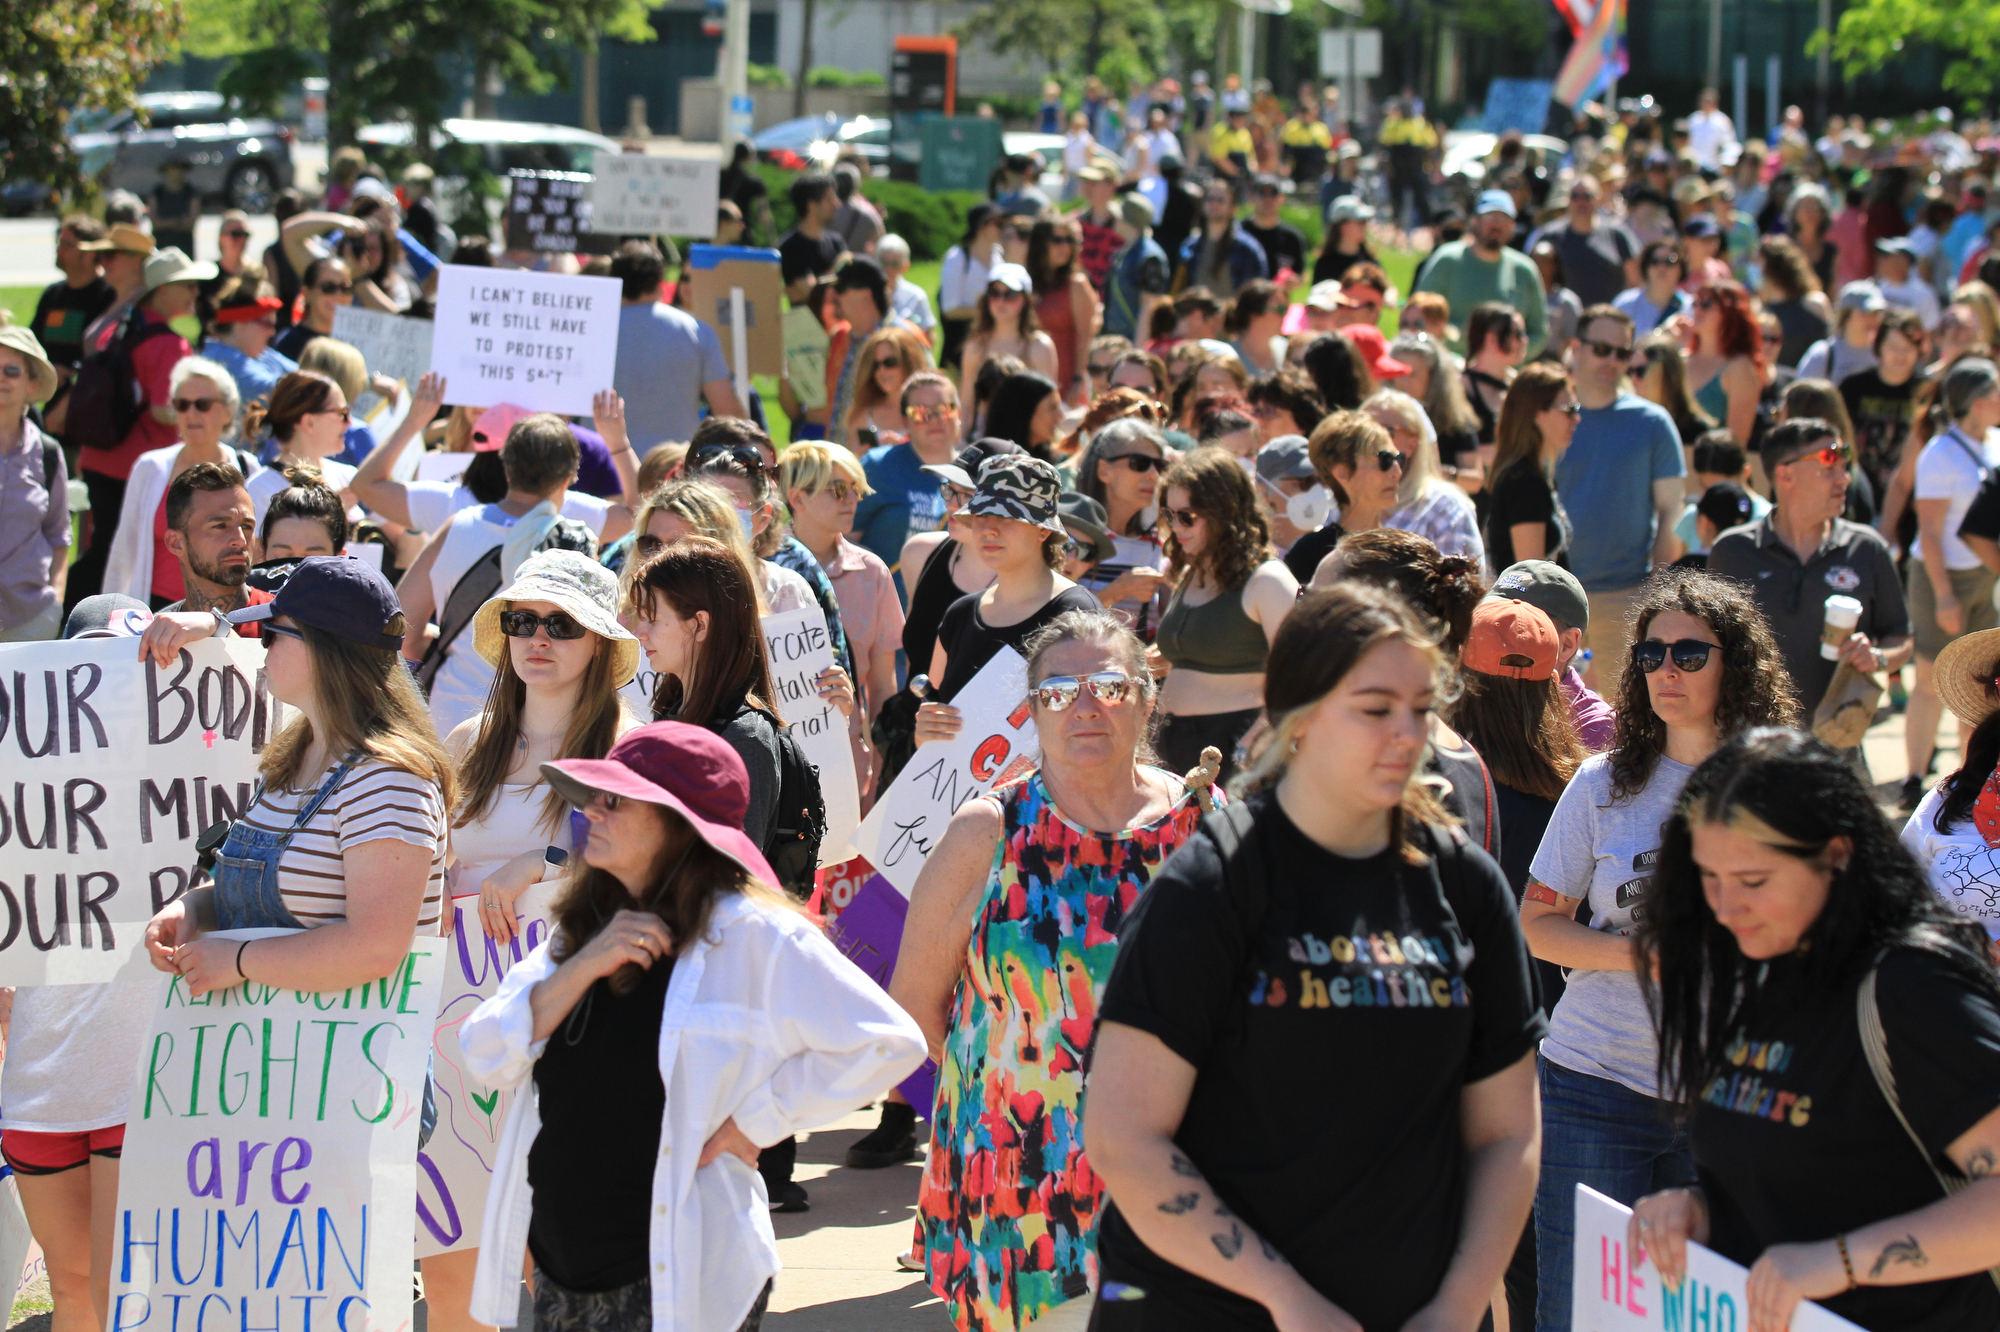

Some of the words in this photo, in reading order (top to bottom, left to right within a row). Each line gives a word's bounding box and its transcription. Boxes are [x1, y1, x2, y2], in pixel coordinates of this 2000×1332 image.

[471, 312, 491, 327] WE
[503, 314, 541, 331] STILL
[552, 318, 587, 335] HAVE
[482, 286, 525, 304] CAN'T
[532, 292, 592, 311] BELIEVE
[476, 337, 493, 353] TO
[506, 341, 574, 361] PROTEST
[480, 365, 515, 381] THIS
[0, 662, 109, 758] UR
[1299, 968, 1471, 1009] healthca
[143, 1017, 405, 1124] RIGHTS
[187, 1136, 312, 1206] are
[120, 1205, 367, 1291] HUMAN
[1602, 1235, 1648, 1318] HE
